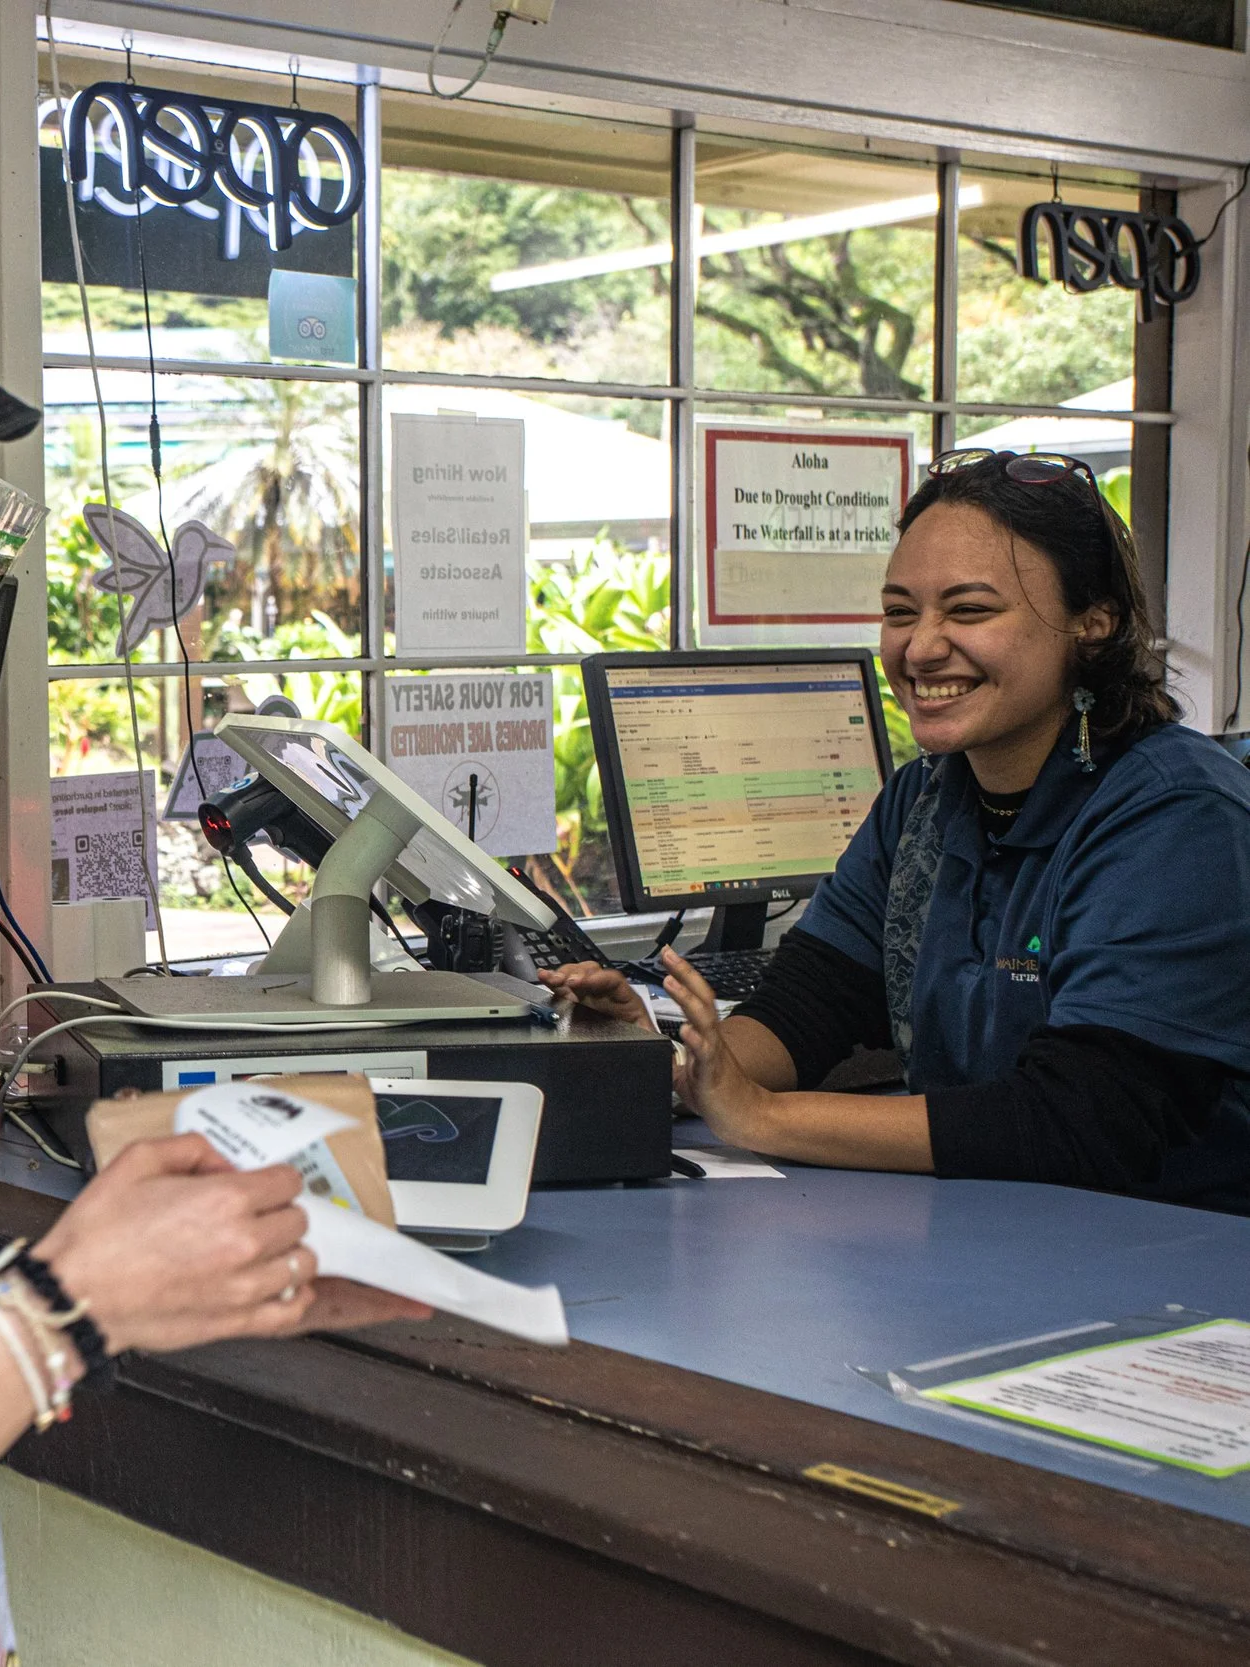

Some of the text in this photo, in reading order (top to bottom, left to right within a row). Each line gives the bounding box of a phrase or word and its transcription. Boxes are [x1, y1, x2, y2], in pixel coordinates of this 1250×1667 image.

[791, 452, 829, 469] Aloha
[734, 487, 889, 510] Due to Drought Conditions
[733, 524, 891, 542] The Waterfall is at a trickle
[772, 889, 790, 899] DELL
